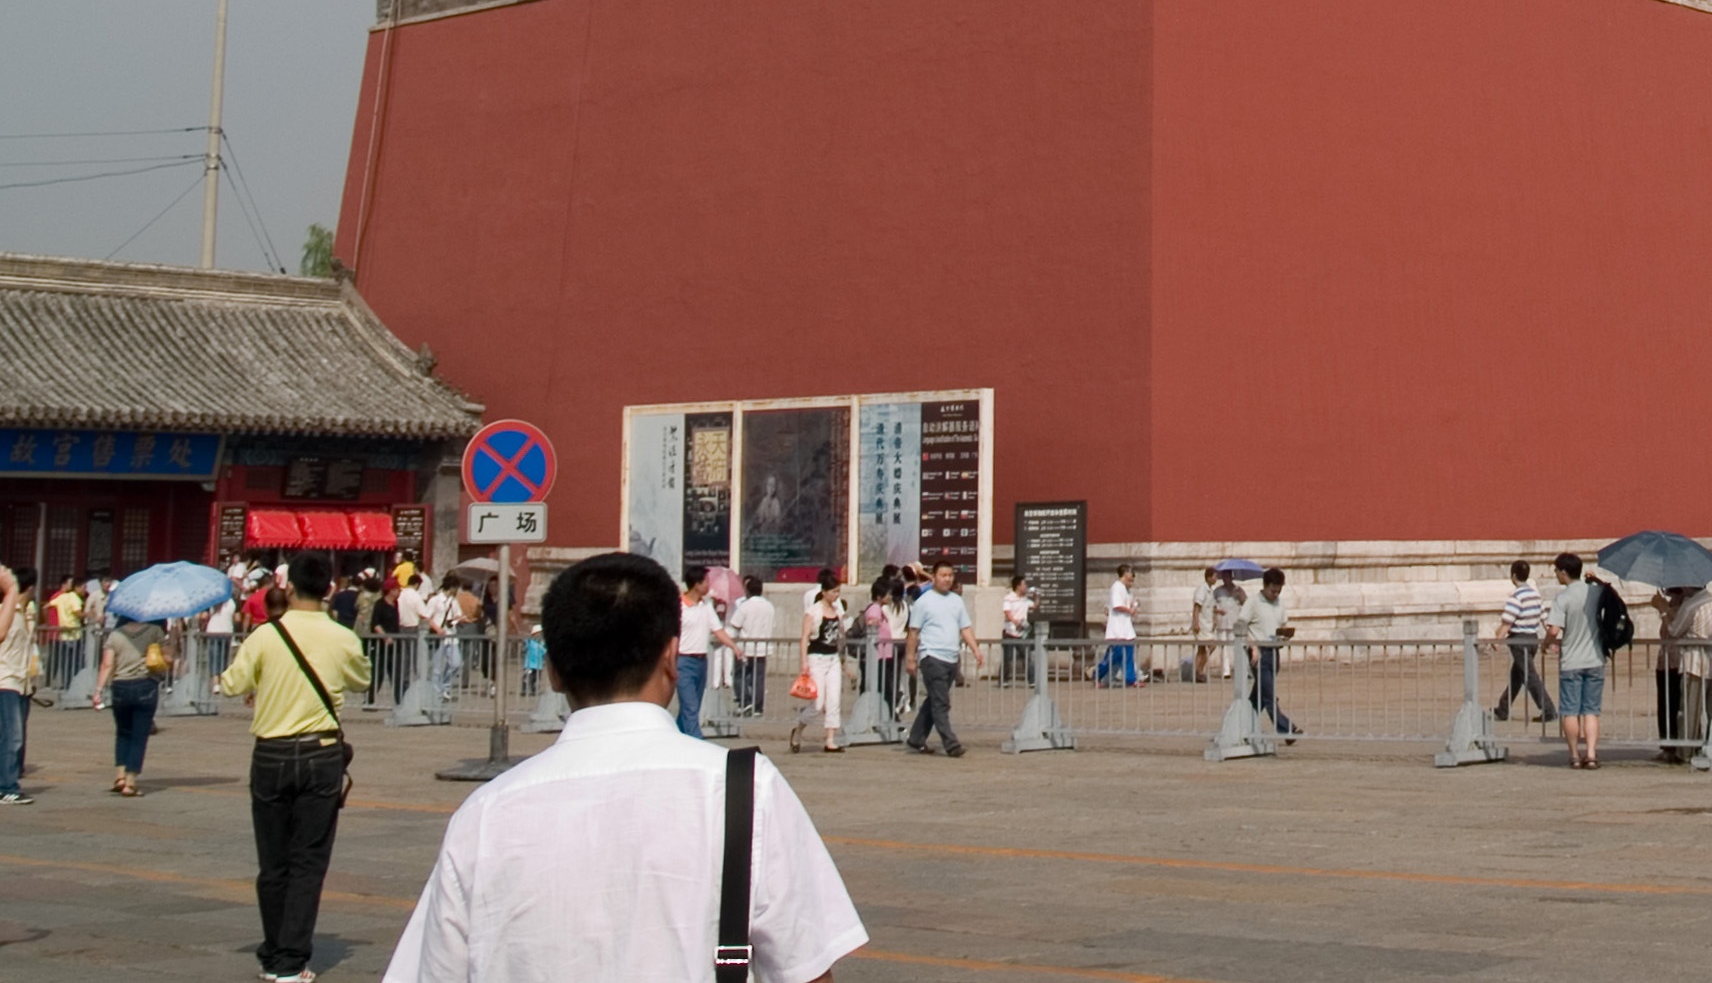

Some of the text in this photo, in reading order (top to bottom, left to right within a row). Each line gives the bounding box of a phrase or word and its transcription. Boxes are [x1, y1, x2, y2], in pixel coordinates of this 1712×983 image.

[9, 433, 193, 468] 故宫售票处
[478, 512, 537, 533] 广场
